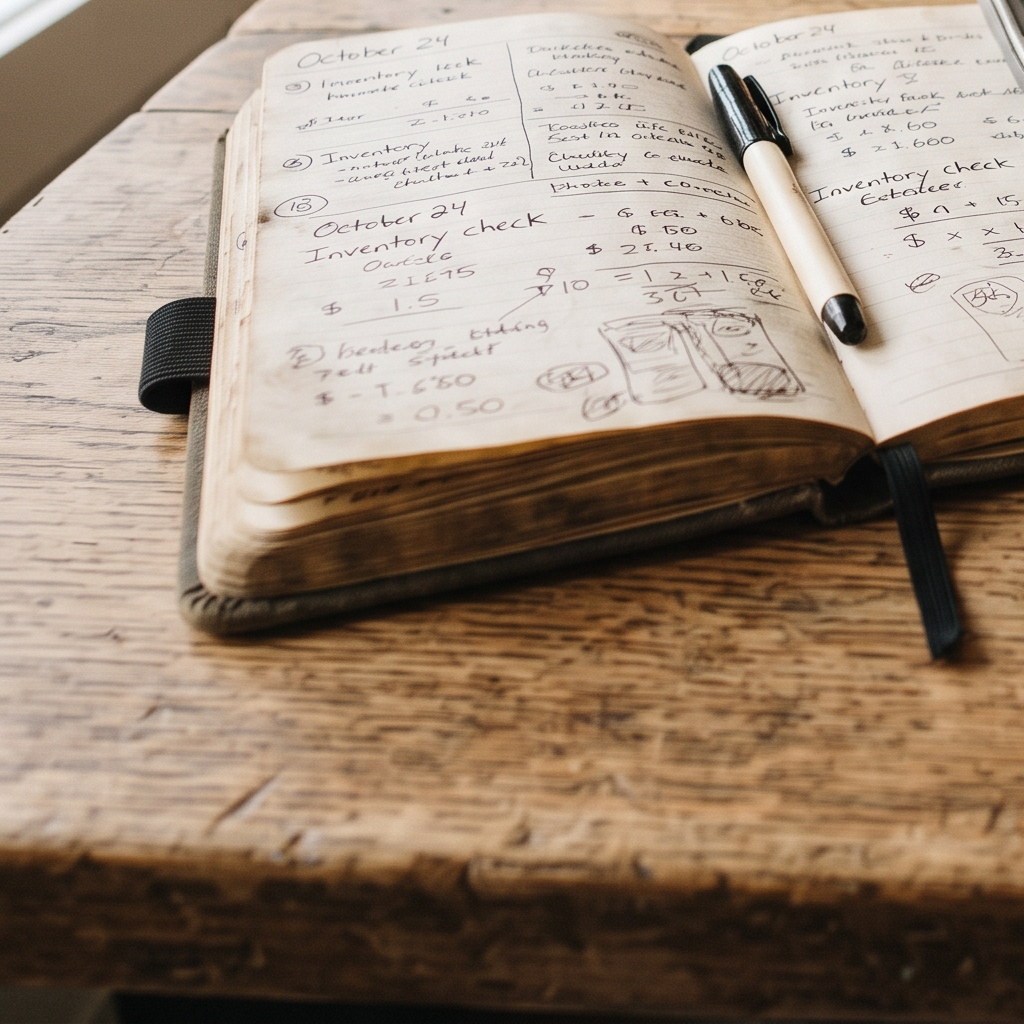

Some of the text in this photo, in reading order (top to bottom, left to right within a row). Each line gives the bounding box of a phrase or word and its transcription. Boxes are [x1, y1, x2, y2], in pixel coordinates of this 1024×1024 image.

[297, 35, 449, 69] October 24
[320, 142, 430, 166] Inventory
[808, 169, 930, 205] Inventory
[943, 158, 1016, 175] check
[304, 231, 448, 264] Inventory
[463, 212, 548, 237] check
[313, 201, 467, 238] October 24
